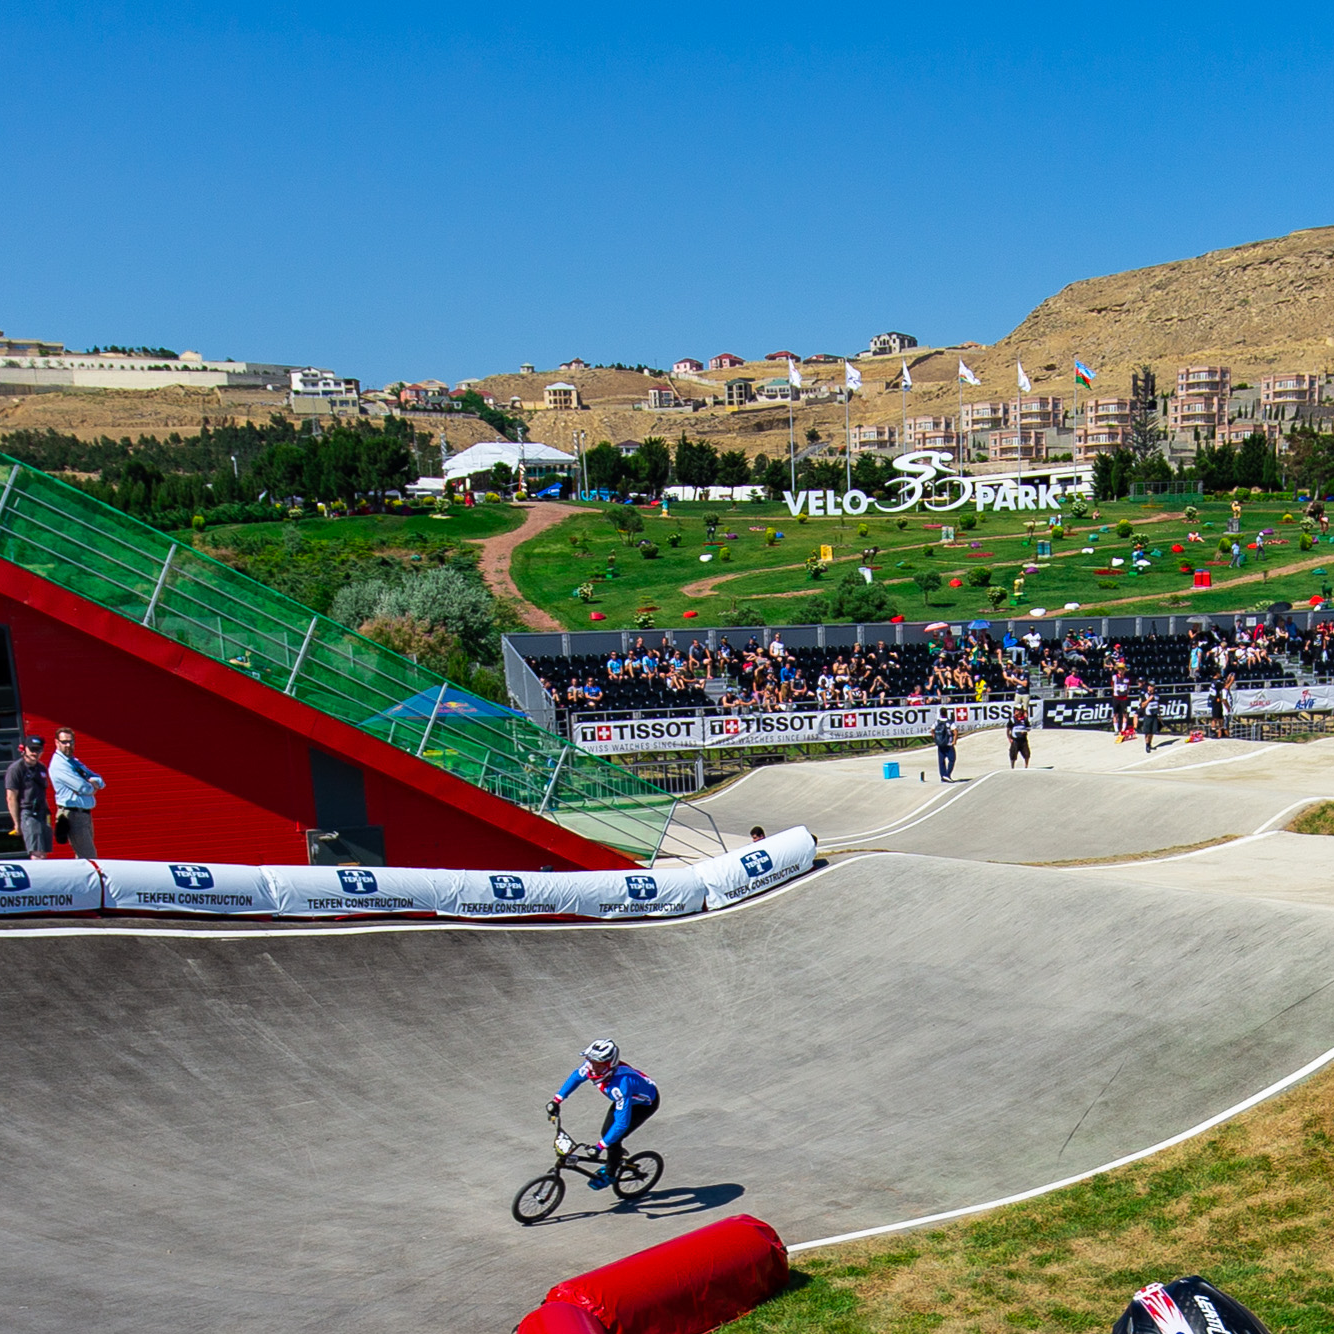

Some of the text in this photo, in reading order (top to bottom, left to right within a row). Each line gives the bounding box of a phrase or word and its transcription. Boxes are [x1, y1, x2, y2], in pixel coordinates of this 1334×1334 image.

[782, 484, 1061, 516] VELO PARK
[859, 709, 931, 727] TISSOT
[970, 703, 1038, 722] TISST
[1074, 703, 1114, 721] faith
[741, 715, 817, 733] TISSOT
[614, 721, 695, 740] TISSOT
[856, 728, 890, 738] WATCHES
[893, 727, 914, 736] SINCE
[777, 734, 800, 742] SINCE
[611, 741, 650, 752] WATCHES
[654, 740, 676, 750] SINCE
[175, 869, 210, 879] TEKFEN
[342, 874, 374, 884] TEKFEN
[494, 881, 522, 890] TEKFEN
[628, 882, 656, 891] TEKFEN
[137, 892, 252, 906] TEKFEN CONSTRUCTION
[307, 897, 414, 909] TEKFEN CONSTRUCTION
[462, 903, 556, 914] TEKFEN CONSTRUCTION
[599, 903, 687, 913] TEKFEN CONSTRUCTION
